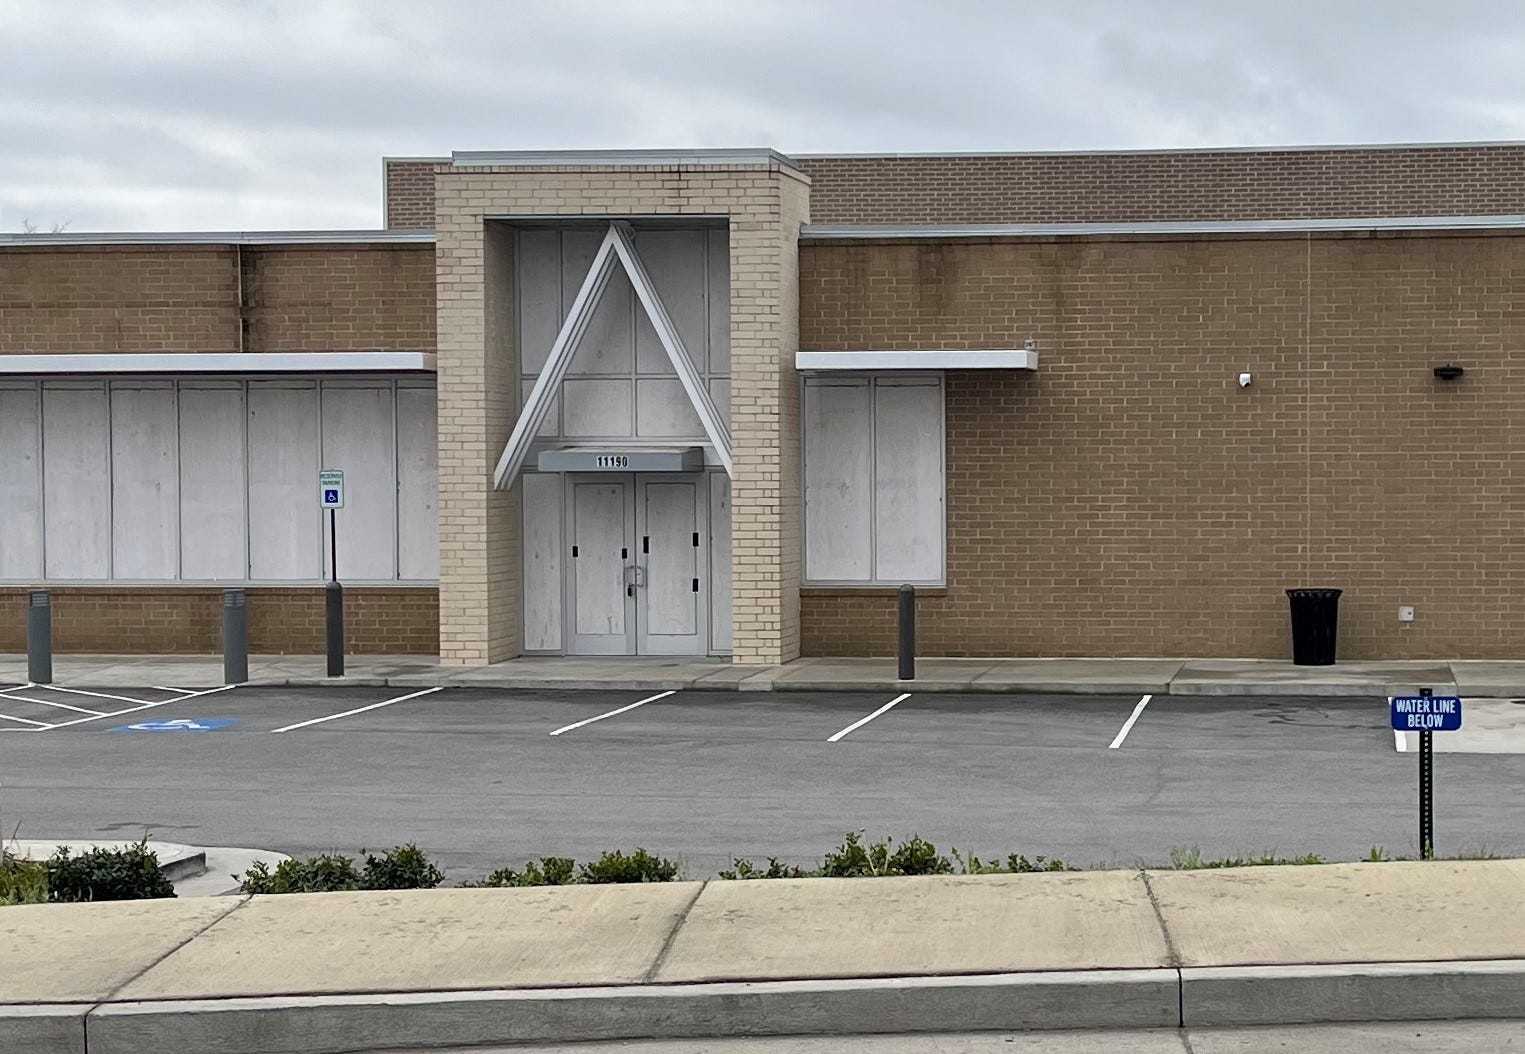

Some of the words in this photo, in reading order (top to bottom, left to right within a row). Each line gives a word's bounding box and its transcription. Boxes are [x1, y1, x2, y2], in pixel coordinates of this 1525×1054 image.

[597, 456, 628, 467] 11190
[1396, 699, 1430, 713] WATER
[1433, 699, 1456, 713] LINE
[1407, 714, 1444, 727] BELOW
